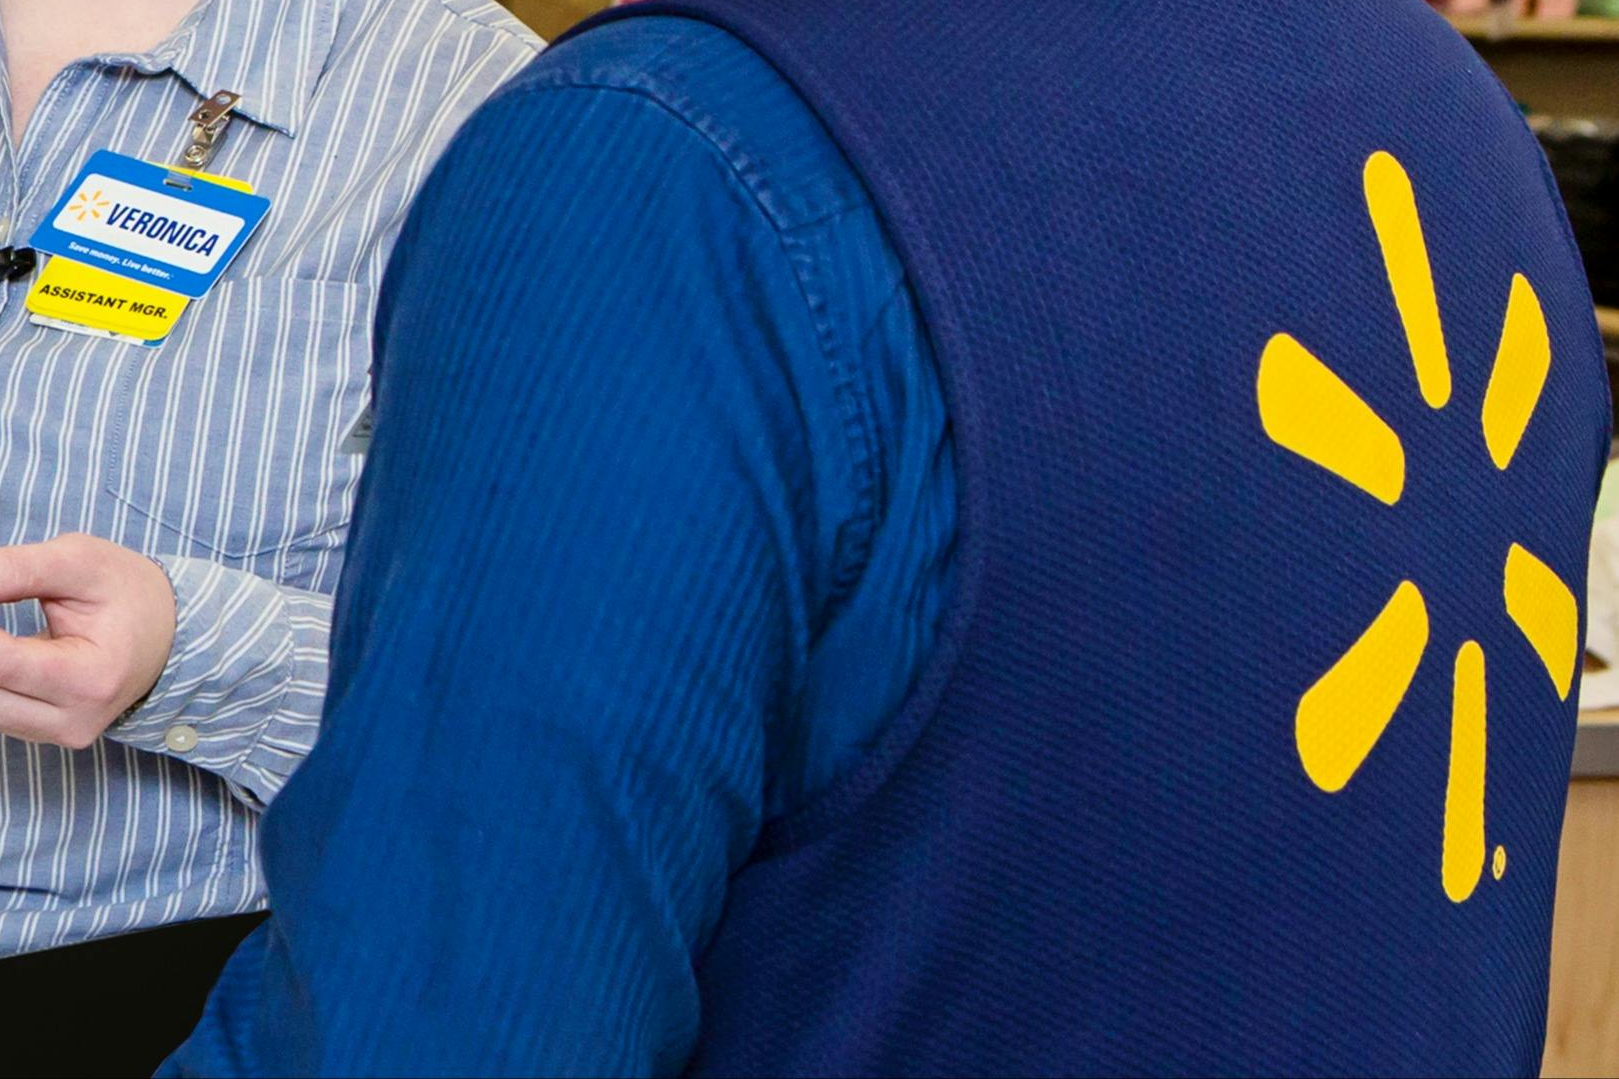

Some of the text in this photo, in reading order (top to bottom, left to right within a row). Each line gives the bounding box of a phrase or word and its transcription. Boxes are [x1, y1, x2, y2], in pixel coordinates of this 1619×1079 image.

[106, 202, 220, 257] VERONICA
[68, 241, 89, 254] Save
[89, 248, 121, 265] money.
[121, 258, 141, 270] Live
[39, 284, 168, 319] ASSISTANT MGR.
